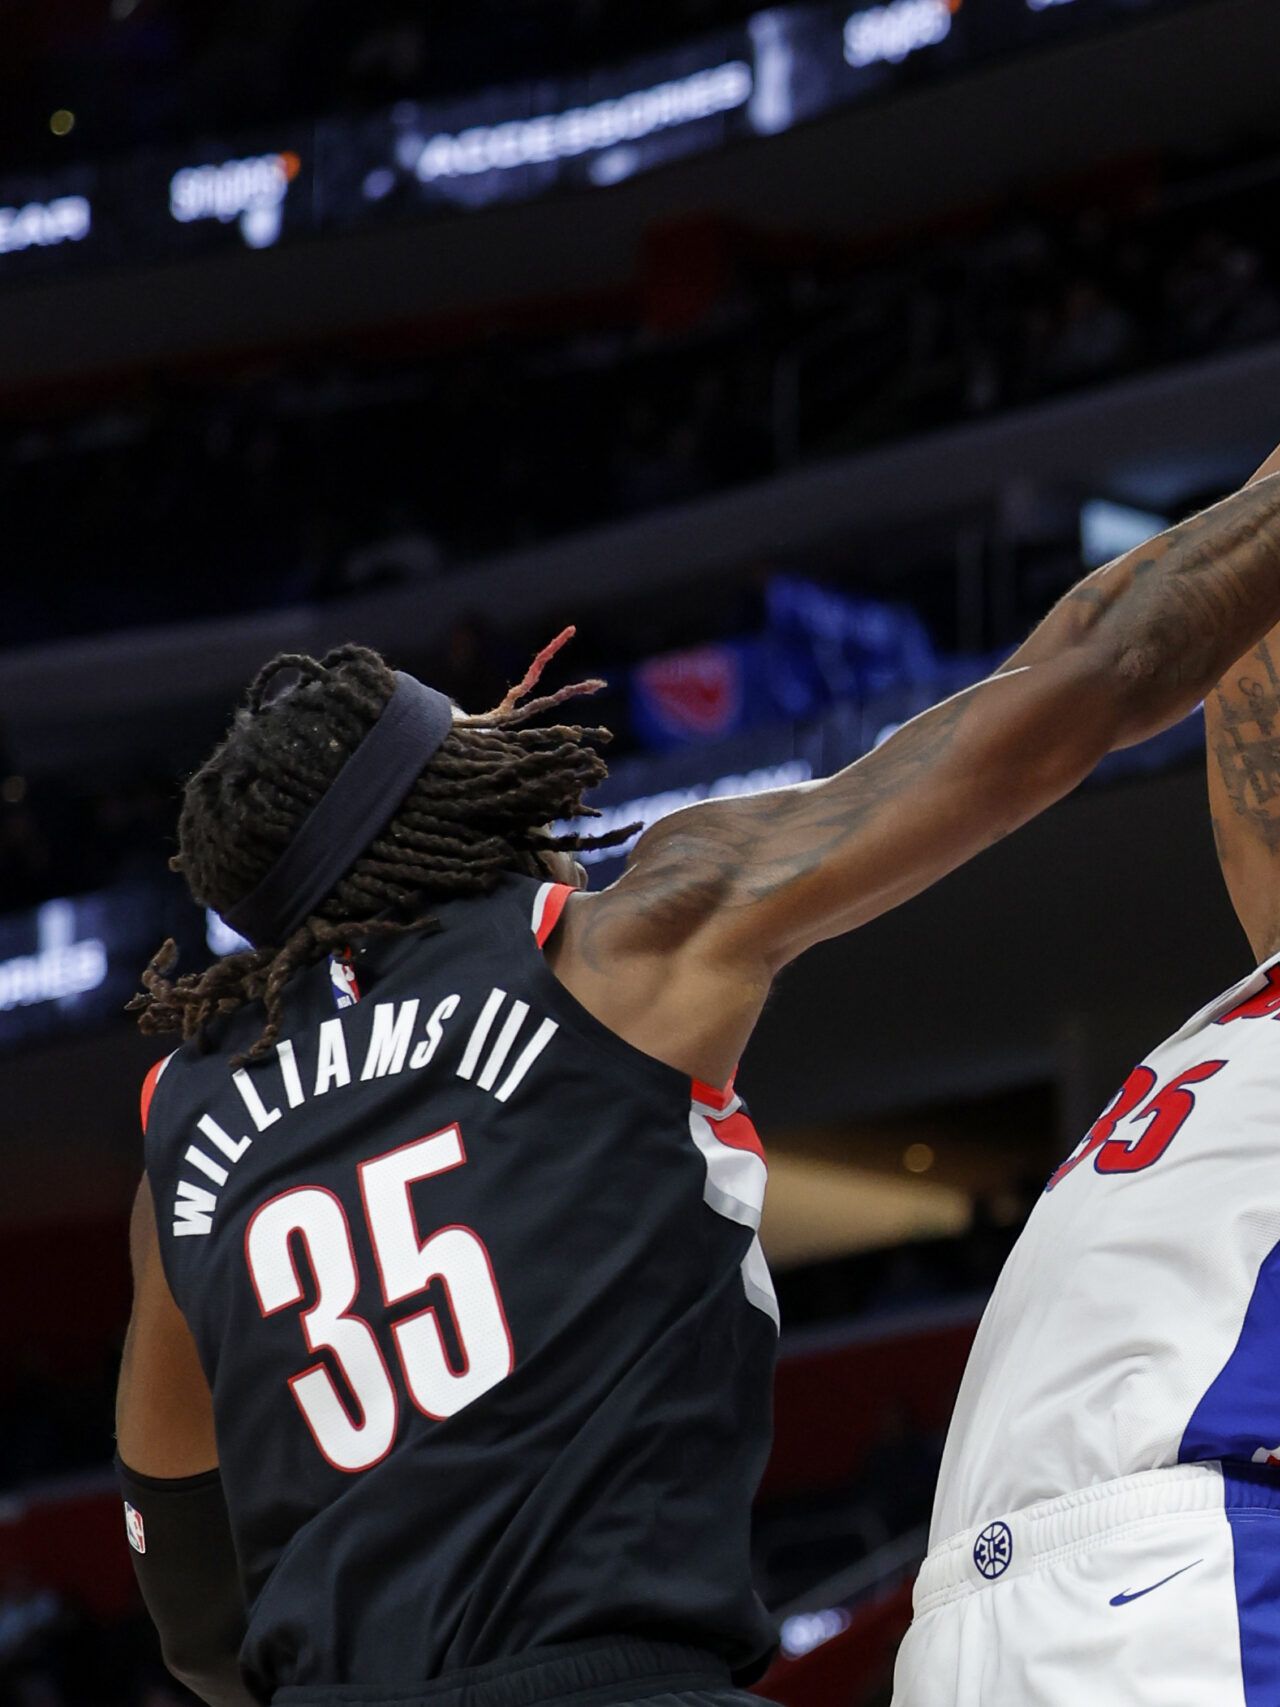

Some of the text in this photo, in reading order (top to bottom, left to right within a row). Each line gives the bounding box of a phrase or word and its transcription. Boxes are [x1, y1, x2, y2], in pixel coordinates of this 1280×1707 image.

[173, 987, 558, 1236] WILLIAMS III
[245, 1121, 514, 1474] 35
